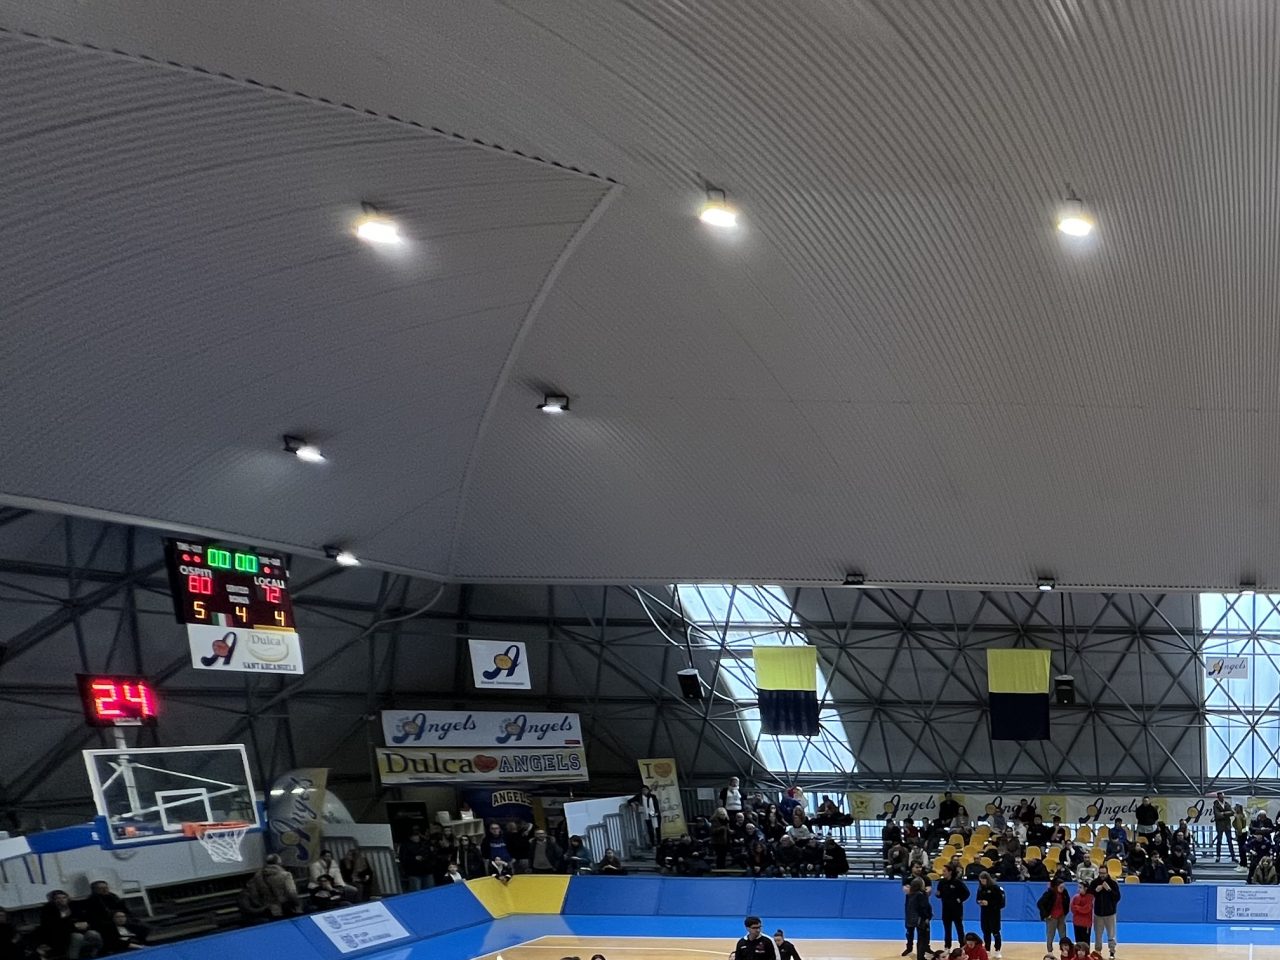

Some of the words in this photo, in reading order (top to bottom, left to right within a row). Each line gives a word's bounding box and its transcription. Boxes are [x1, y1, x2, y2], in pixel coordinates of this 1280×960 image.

[189, 576, 212, 594] 80
[262, 586, 280, 603] 72
[194, 601, 205, 619] 5
[235, 606, 246, 622] 4
[274, 611, 285, 626] 4
[92, 684, 150, 716] 24
[392, 712, 477, 744] Angels
[495, 714, 574, 744] Angels
[381, 752, 476, 774] Dulca
[499, 753, 581, 773] ANGELS
[876, 794, 936, 820] Angels
